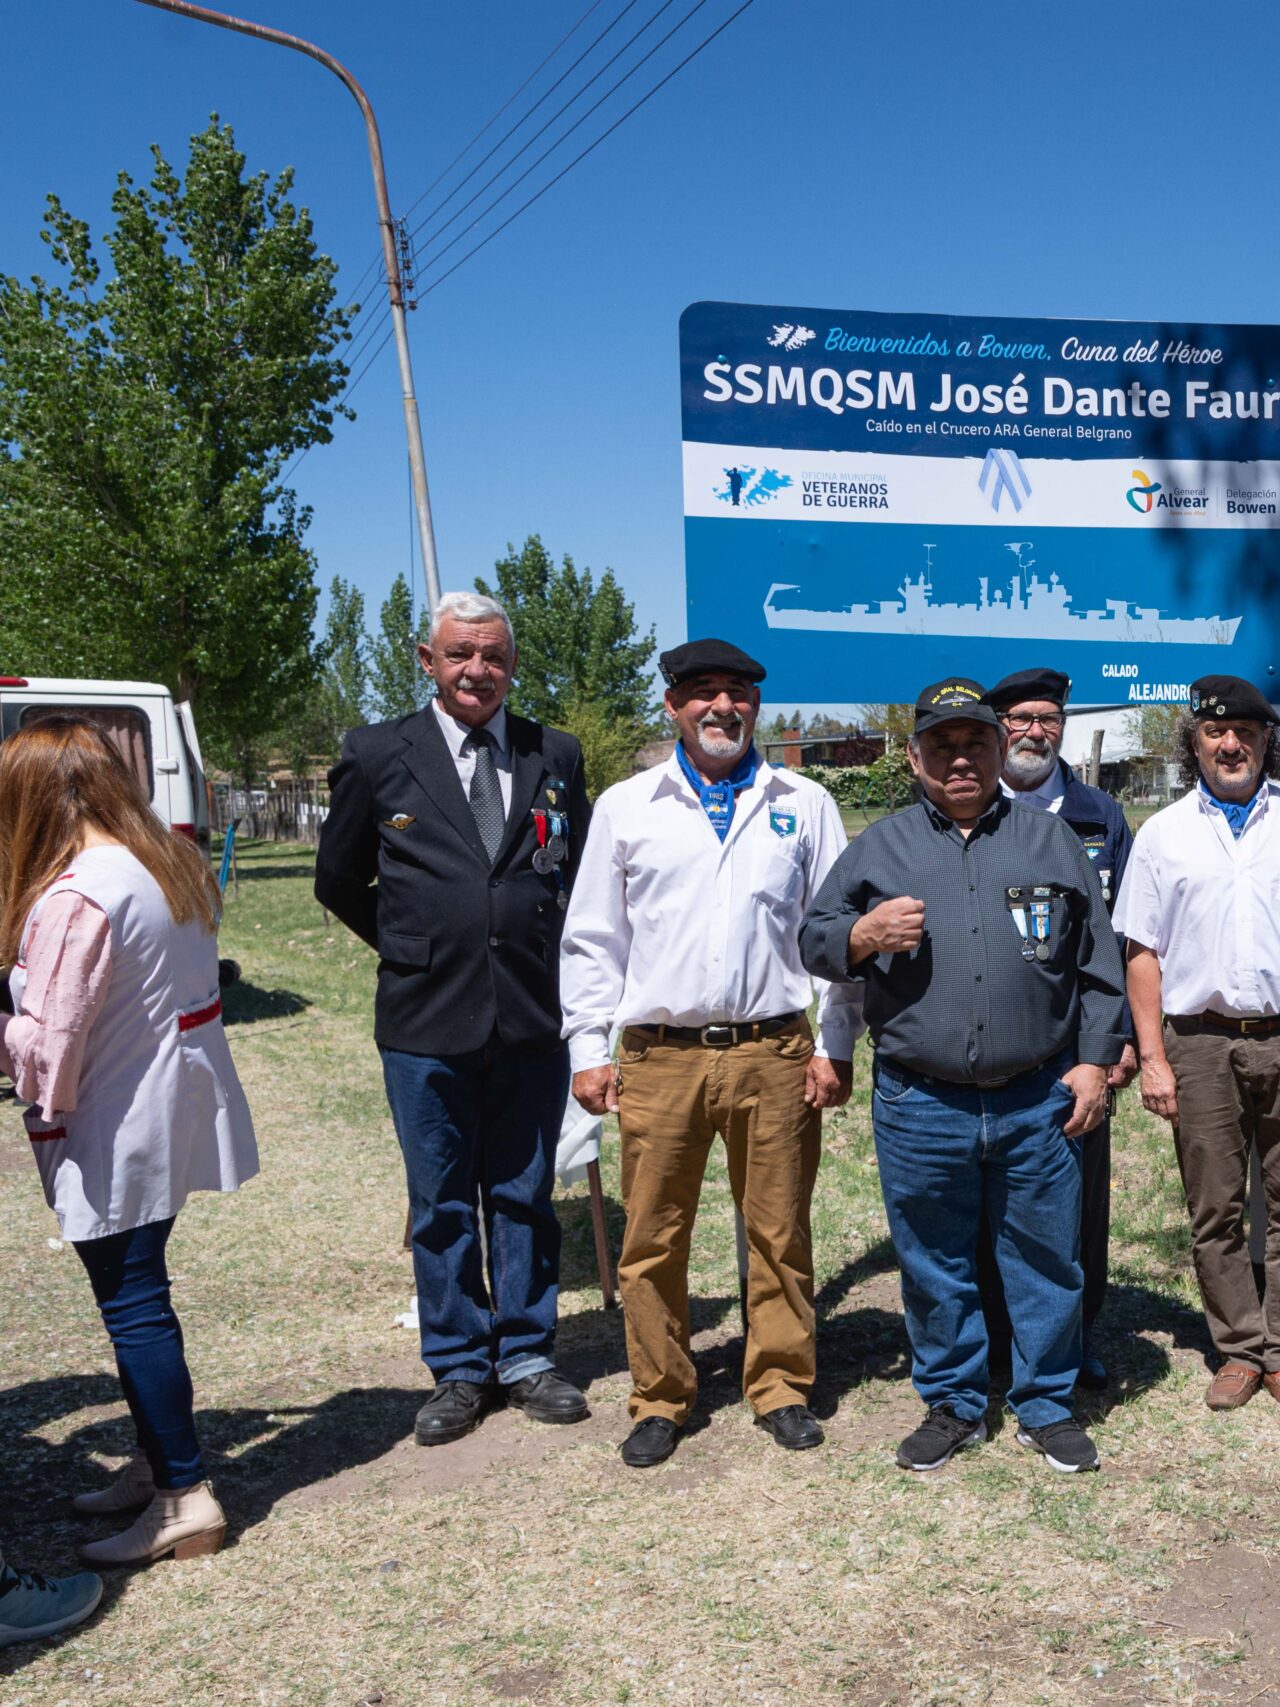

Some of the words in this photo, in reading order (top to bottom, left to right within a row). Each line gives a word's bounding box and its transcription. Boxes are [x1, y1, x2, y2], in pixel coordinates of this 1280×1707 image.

[824, 327, 950, 357] Bienvenidos
[955, 341, 972, 357] a
[1061, 336, 1118, 363] Cuna
[1122, 339, 1157, 363] del
[1162, 340, 1223, 365] Héroe
[703, 361, 916, 415] SSMQSM
[929, 372, 1028, 414] José
[1043, 377, 1171, 418] Dante
[1185, 381, 1280, 420] Faur
[865, 419, 903, 433] Caído
[906, 423, 922, 433] en
[925, 421, 937, 434] el
[940, 422, 991, 436] Crucero
[993, 424, 1020, 436] ARA
[1023, 425, 1072, 438] General
[1076, 426, 1132, 441] Belgrano
[801, 471, 838, 481] OFICINA
[802, 481, 888, 495] VETERANOS
[1173, 487, 1206, 496] General
[1226, 488, 1277, 500] Delegación
[802, 494, 822, 507] DE
[826, 495, 889, 509] GUERRA
[1156, 493, 1209, 508] Alvear
[1226, 500, 1276, 514] Bowen
[1102, 664, 1139, 678] CALADO
[940, 686, 956, 696] GRAL
